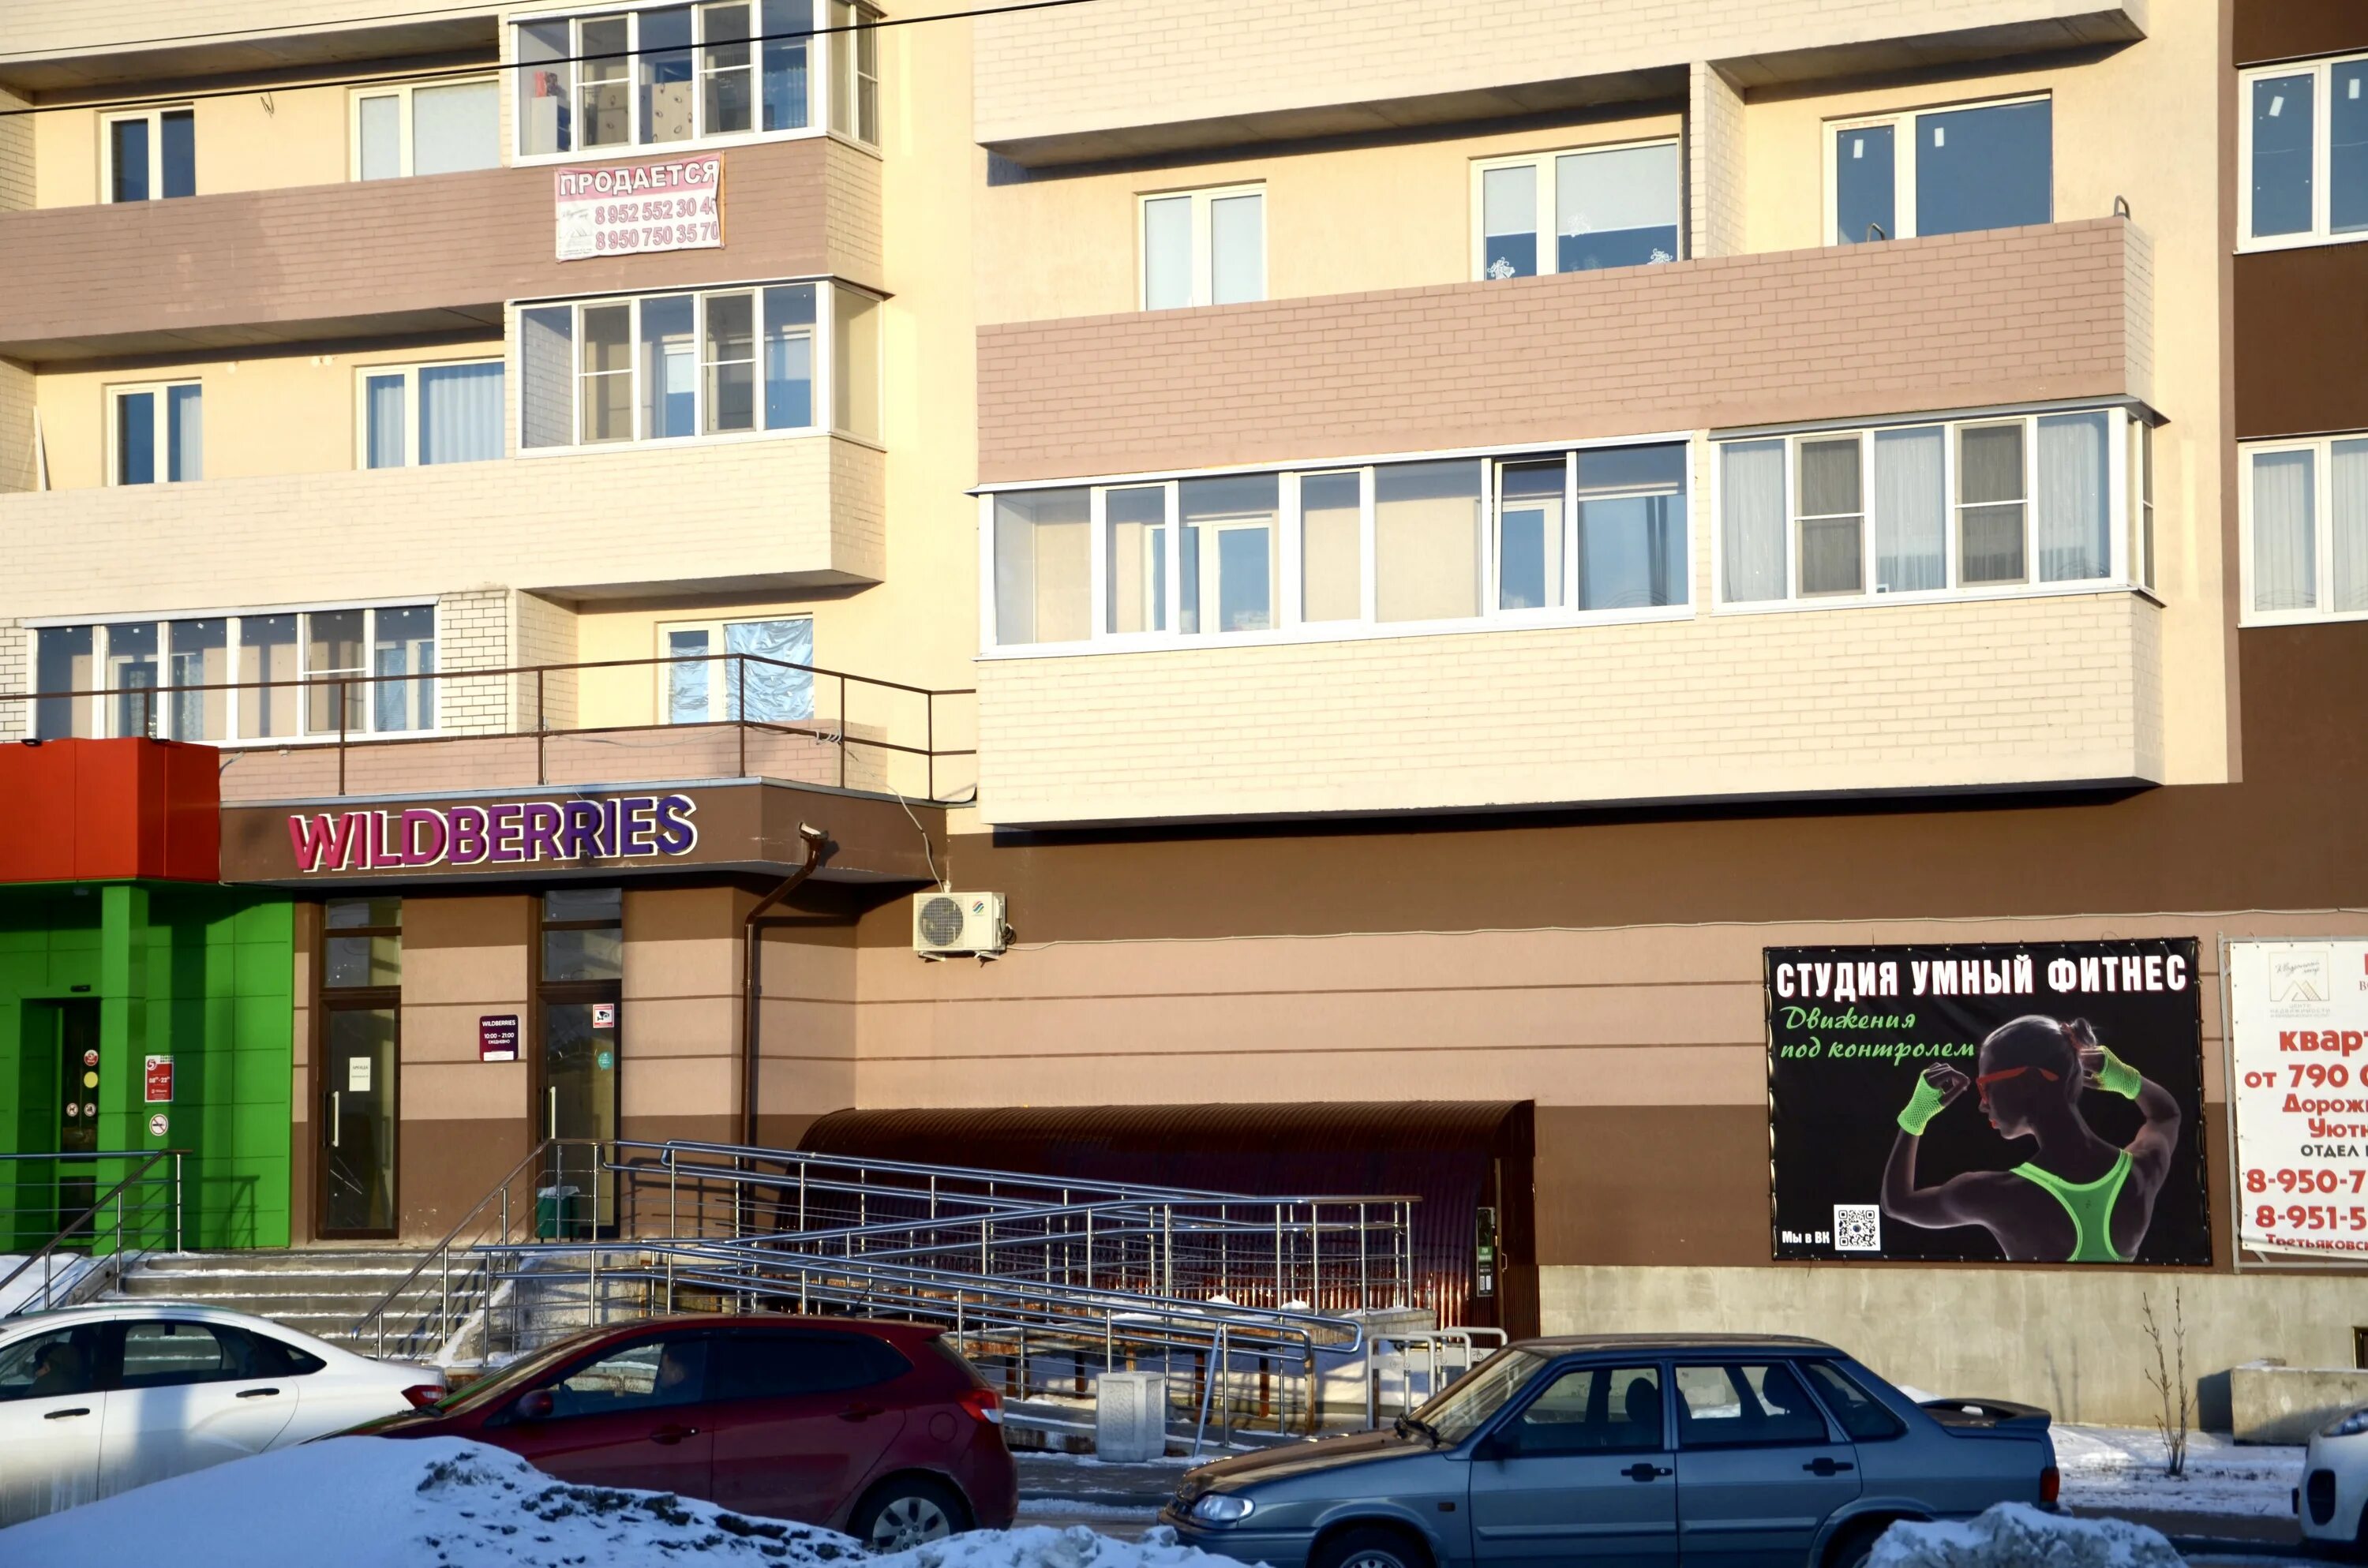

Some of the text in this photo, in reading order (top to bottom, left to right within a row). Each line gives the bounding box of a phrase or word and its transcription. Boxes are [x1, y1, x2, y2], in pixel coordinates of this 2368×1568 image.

[559, 160, 720, 196] ПРОДАЕТСЯ
[594, 206, 605, 225] 8
[607, 203, 639, 224] 952
[642, 200, 673, 221] 552
[676, 197, 697, 218] 30
[595, 221, 720, 250] 8 950 750 35 70
[287, 794, 698, 873] WILDBERRIES
[1776, 954, 2187, 1004] СТУДИЯ УМНЫЙ ФИТНЕС
[1779, 1005, 1917, 1030] Движения
[1780, 1036, 1975, 1067] под контролем
[2244, 1071, 2277, 1088] от
[2287, 1063, 2349, 1088] 790
[2282, 1093, 2368, 1117] Дорож
[2300, 1144, 2359, 1158] ОТДЕЛ
[1782, 1230, 1830, 1244] Мы в ВК
